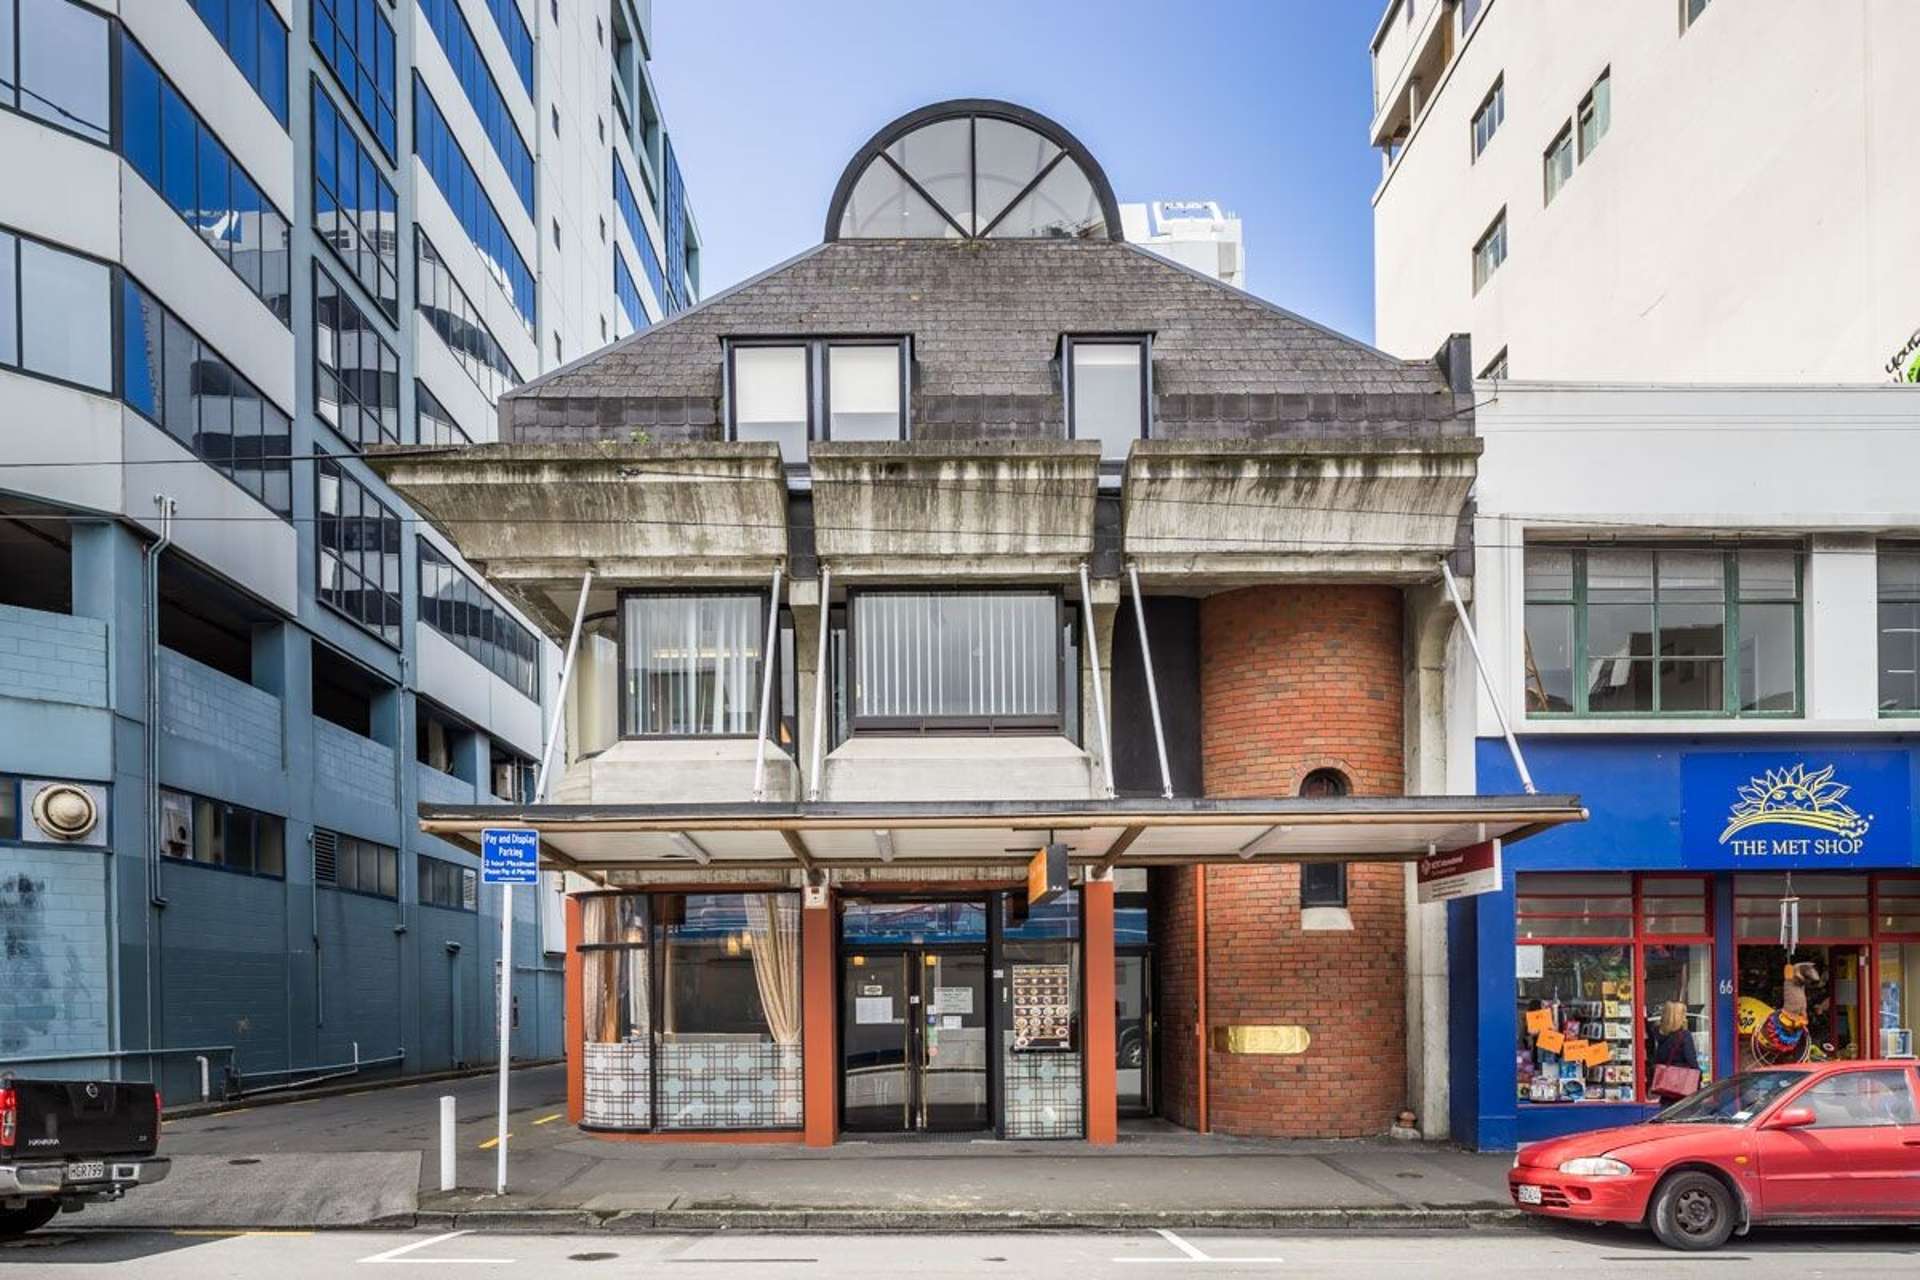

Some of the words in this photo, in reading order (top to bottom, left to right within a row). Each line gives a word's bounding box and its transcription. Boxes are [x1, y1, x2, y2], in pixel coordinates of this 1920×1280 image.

[485, 833, 497, 846] Pay
[498, 834, 511, 844] and
[512, 833, 536, 846] Display
[498, 845, 524, 858] Parking
[1730, 840, 1768, 856] THE
[1773, 839, 1811, 855] MET
[1814, 839, 1863, 855] SHOP
[1720, 980, 1734, 994] 66
